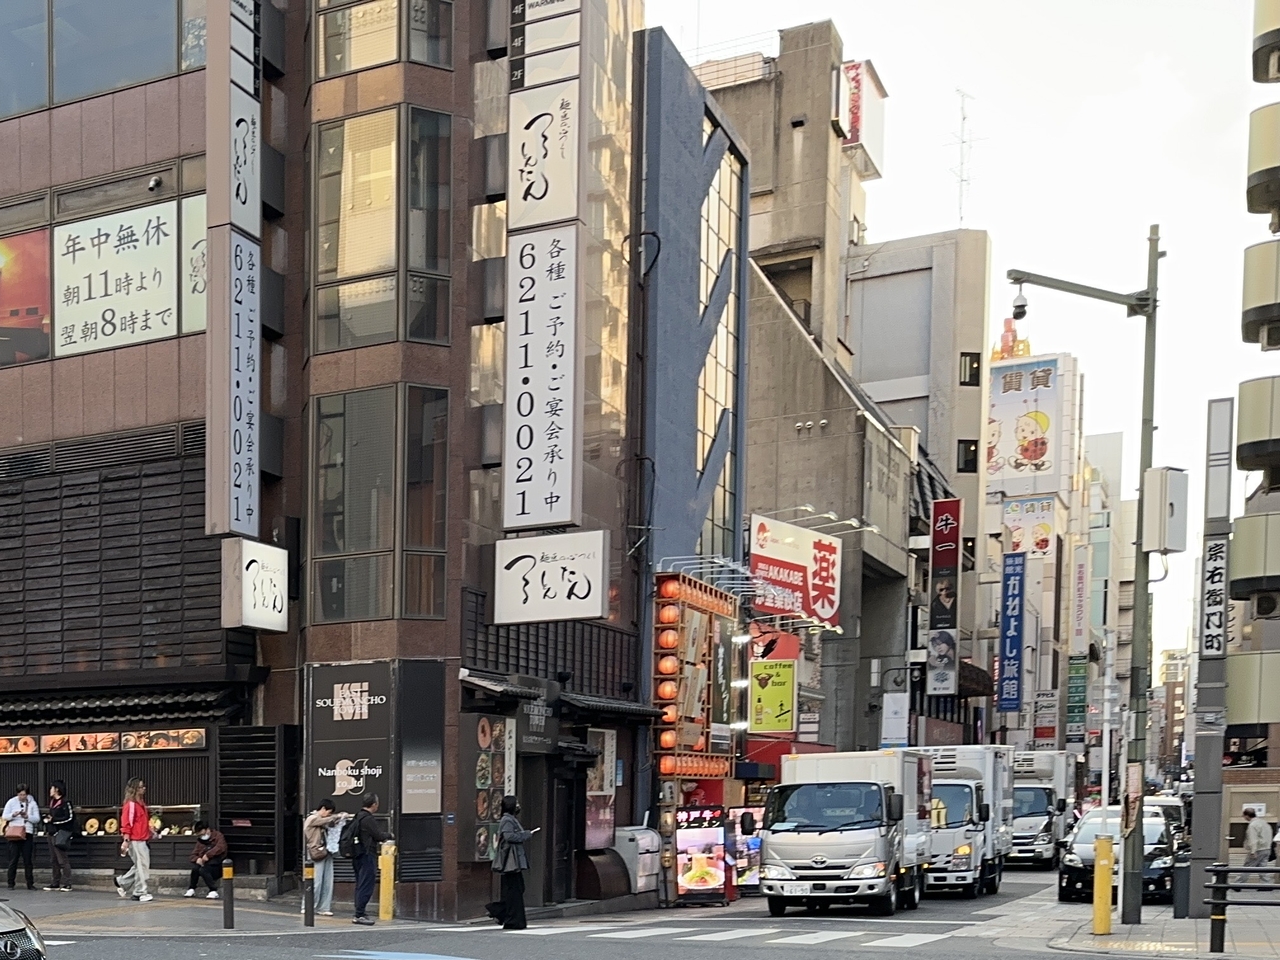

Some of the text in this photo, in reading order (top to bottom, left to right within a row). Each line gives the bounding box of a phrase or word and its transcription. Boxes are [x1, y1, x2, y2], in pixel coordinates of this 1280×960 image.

[512, 4, 524, 15] 4F
[512, 36, 524, 48] 4F
[511, 69, 524, 81] 2F
[60, 215, 171, 265] 年中無休
[61, 267, 163, 307] 朝11時より
[59, 307, 173, 348] 翌朝8時まで
[1001, 368, 1053, 394] 賃貸
[935, 513, 958, 551] 牛一
[768, 565, 804, 586] AKAKABE
[1205, 543, 1226, 652] 宗右衛門町
[763, 662, 793, 670] coffee
[339, 688, 362, 698] EAST
[332, 705, 369, 715] TOWER
[318, 765, 383, 778] Nanboku shoji
[676, 810, 714, 822] 神戸牛
[679, 820, 720, 829] ラーメン
